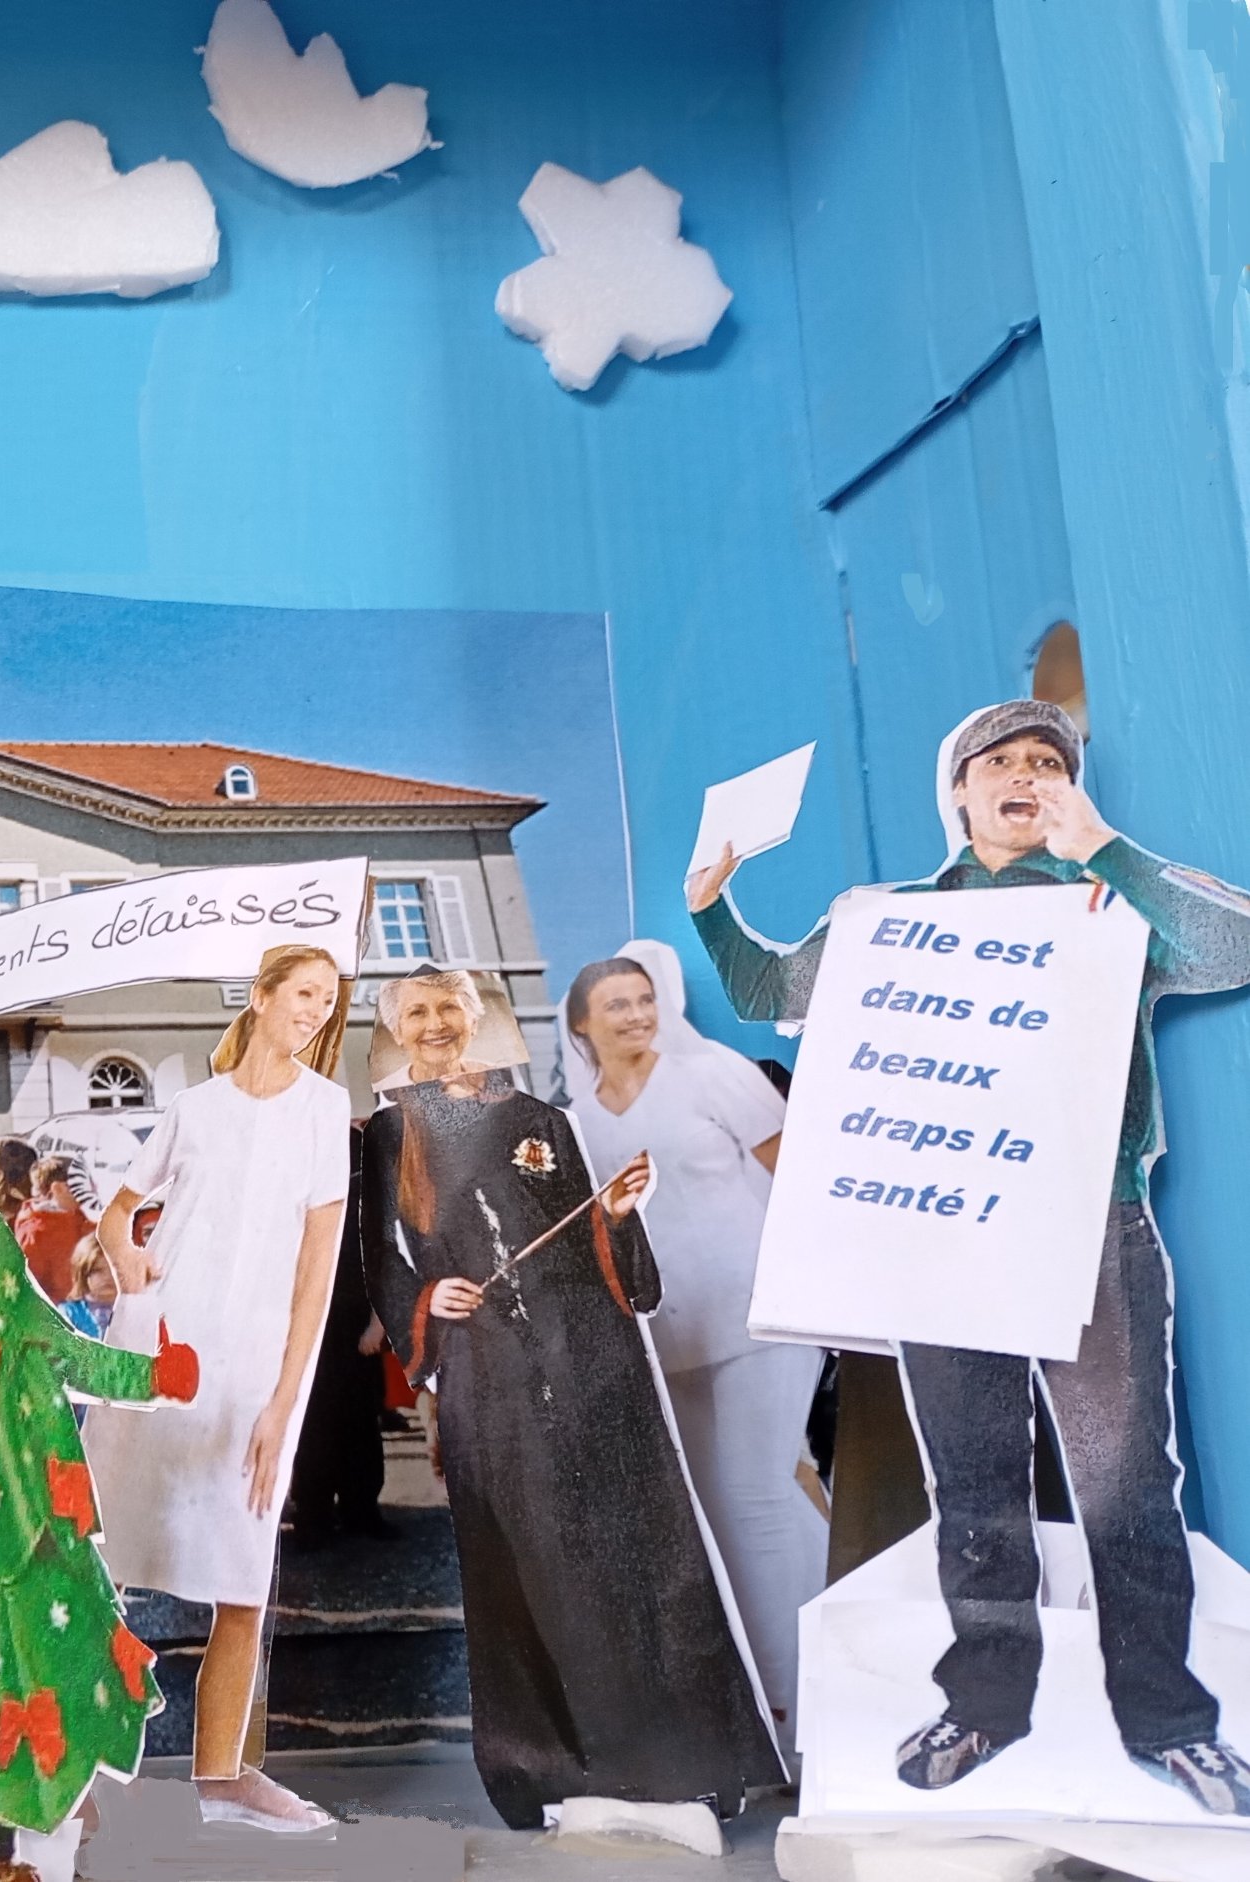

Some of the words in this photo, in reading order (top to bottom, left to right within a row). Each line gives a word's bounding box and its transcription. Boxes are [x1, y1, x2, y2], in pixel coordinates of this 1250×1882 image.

[869, 917, 960, 954] Elle
[973, 939, 1055, 969] est
[860, 980, 975, 1020] dans
[988, 999, 1049, 1031] de
[848, 1041, 1000, 1090] beaux
[840, 1106, 975, 1152] draps
[987, 1128, 1035, 1163] la
